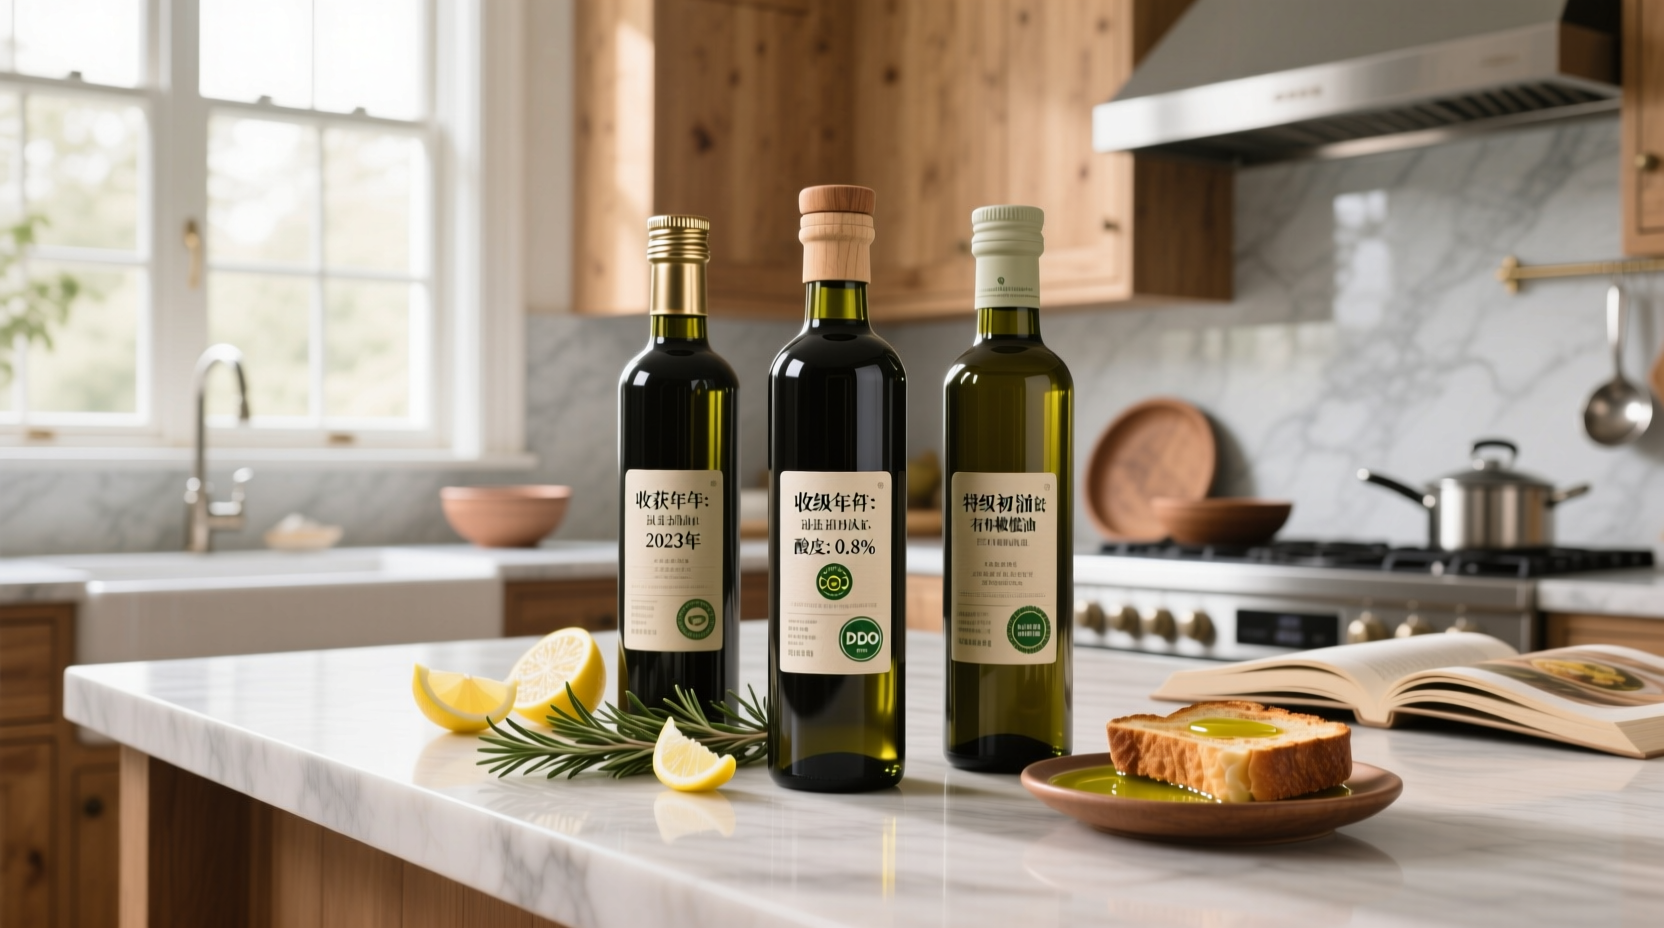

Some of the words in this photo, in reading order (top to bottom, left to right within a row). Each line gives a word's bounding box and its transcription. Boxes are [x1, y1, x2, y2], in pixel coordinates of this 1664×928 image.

[646, 531, 701, 550] 2023年
[835, 538, 876, 555] 0.8%
[846, 631, 879, 646] DDO
